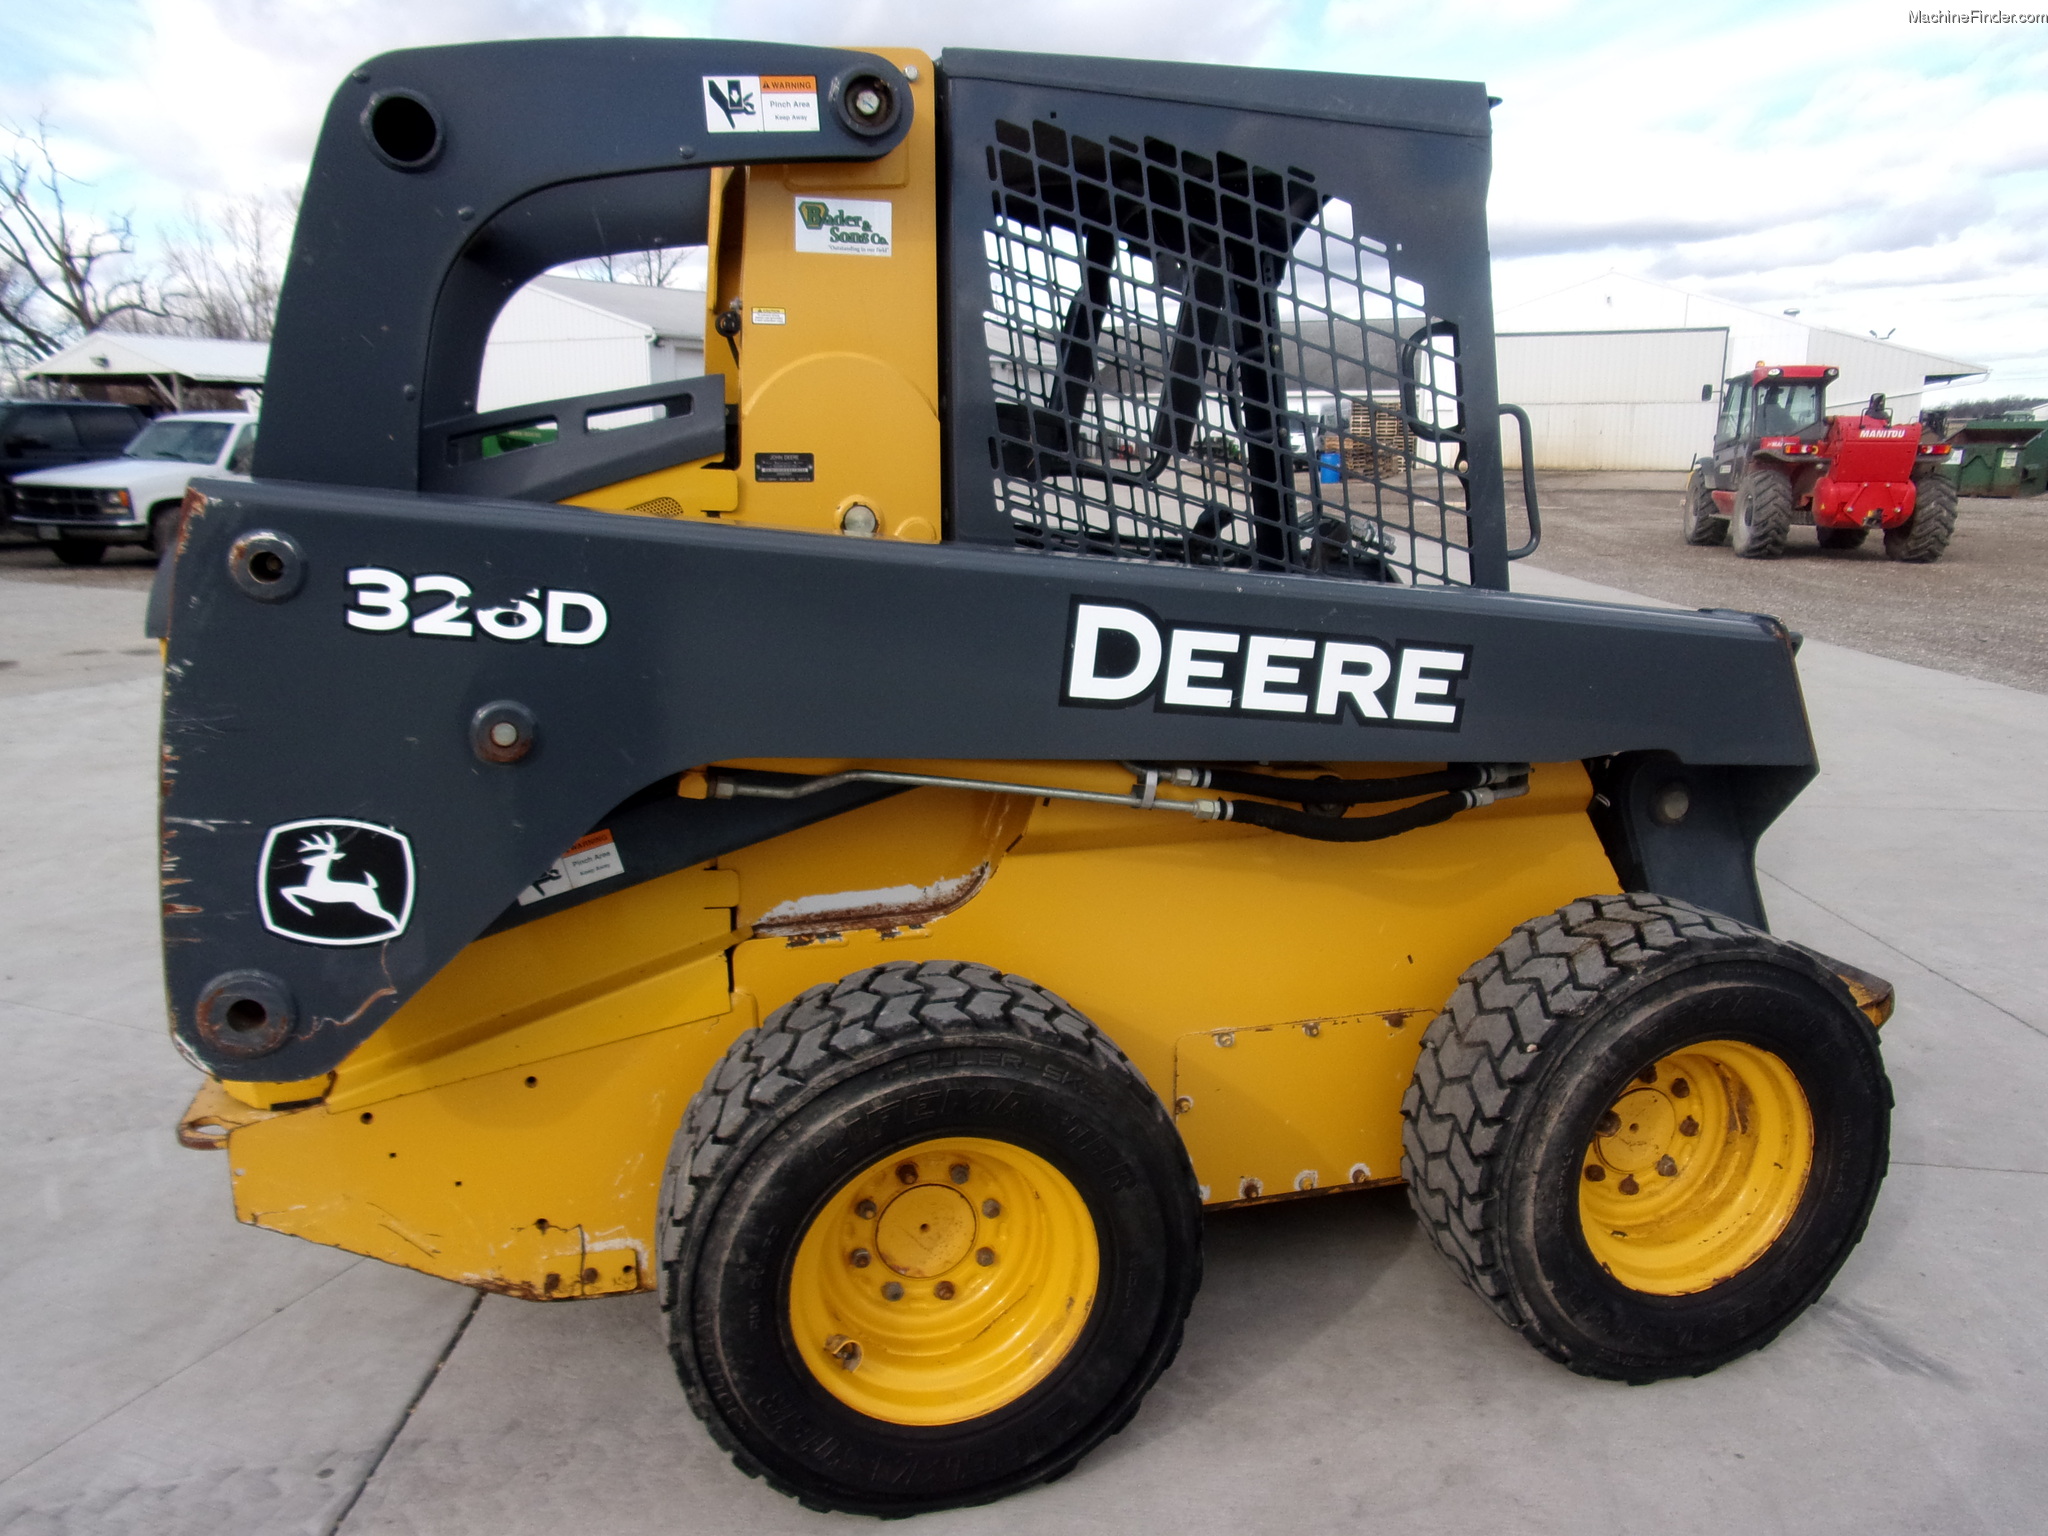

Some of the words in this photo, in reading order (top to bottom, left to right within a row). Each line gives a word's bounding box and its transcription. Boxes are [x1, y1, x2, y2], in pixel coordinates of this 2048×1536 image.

[771, 81, 811, 89] WARNING
[770, 100, 791, 108] Pinch
[794, 100, 810, 108] Area
[829, 226, 870, 244] Sons
[1860, 430, 1905, 438] MANITOU
[1069, 604, 1465, 723] DEERE
[572, 857, 593, 867] Pinch
[594, 851, 611, 860] Area
